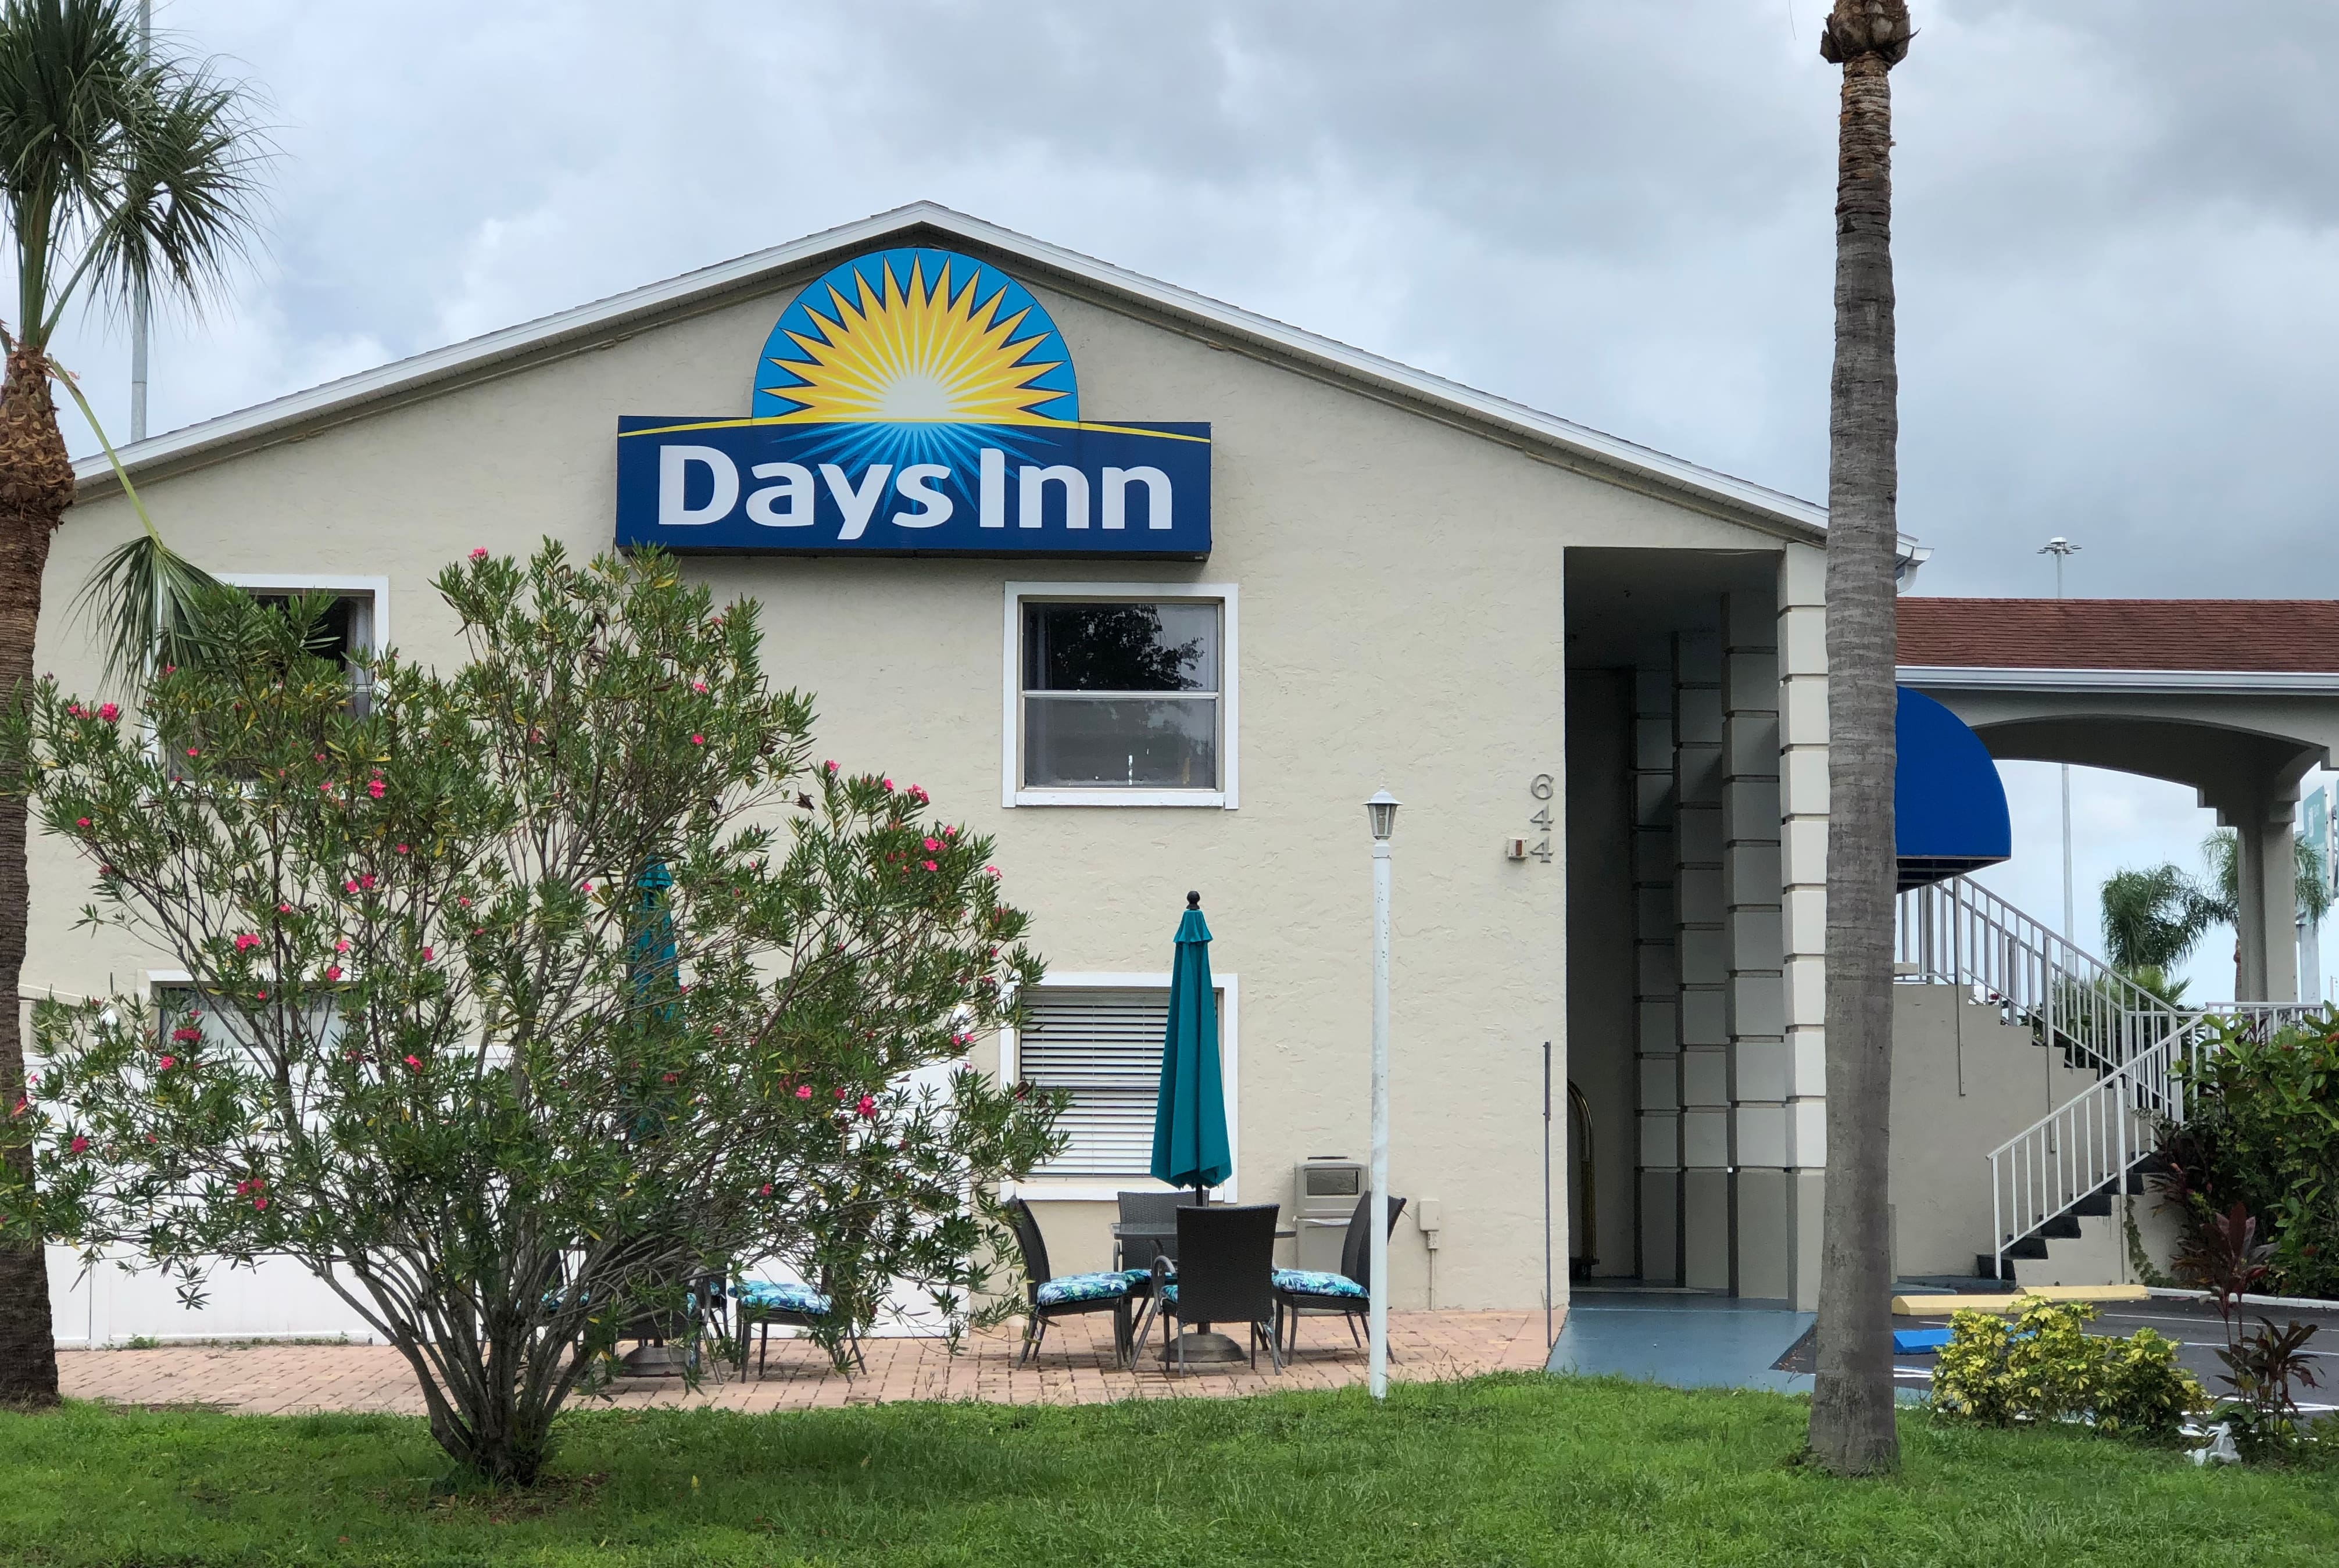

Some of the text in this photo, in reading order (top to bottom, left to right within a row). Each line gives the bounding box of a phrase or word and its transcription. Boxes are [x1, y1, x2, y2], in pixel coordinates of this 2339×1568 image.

[659, 445, 1172, 540] Days Inn
[1530, 774, 1554, 864] 644
